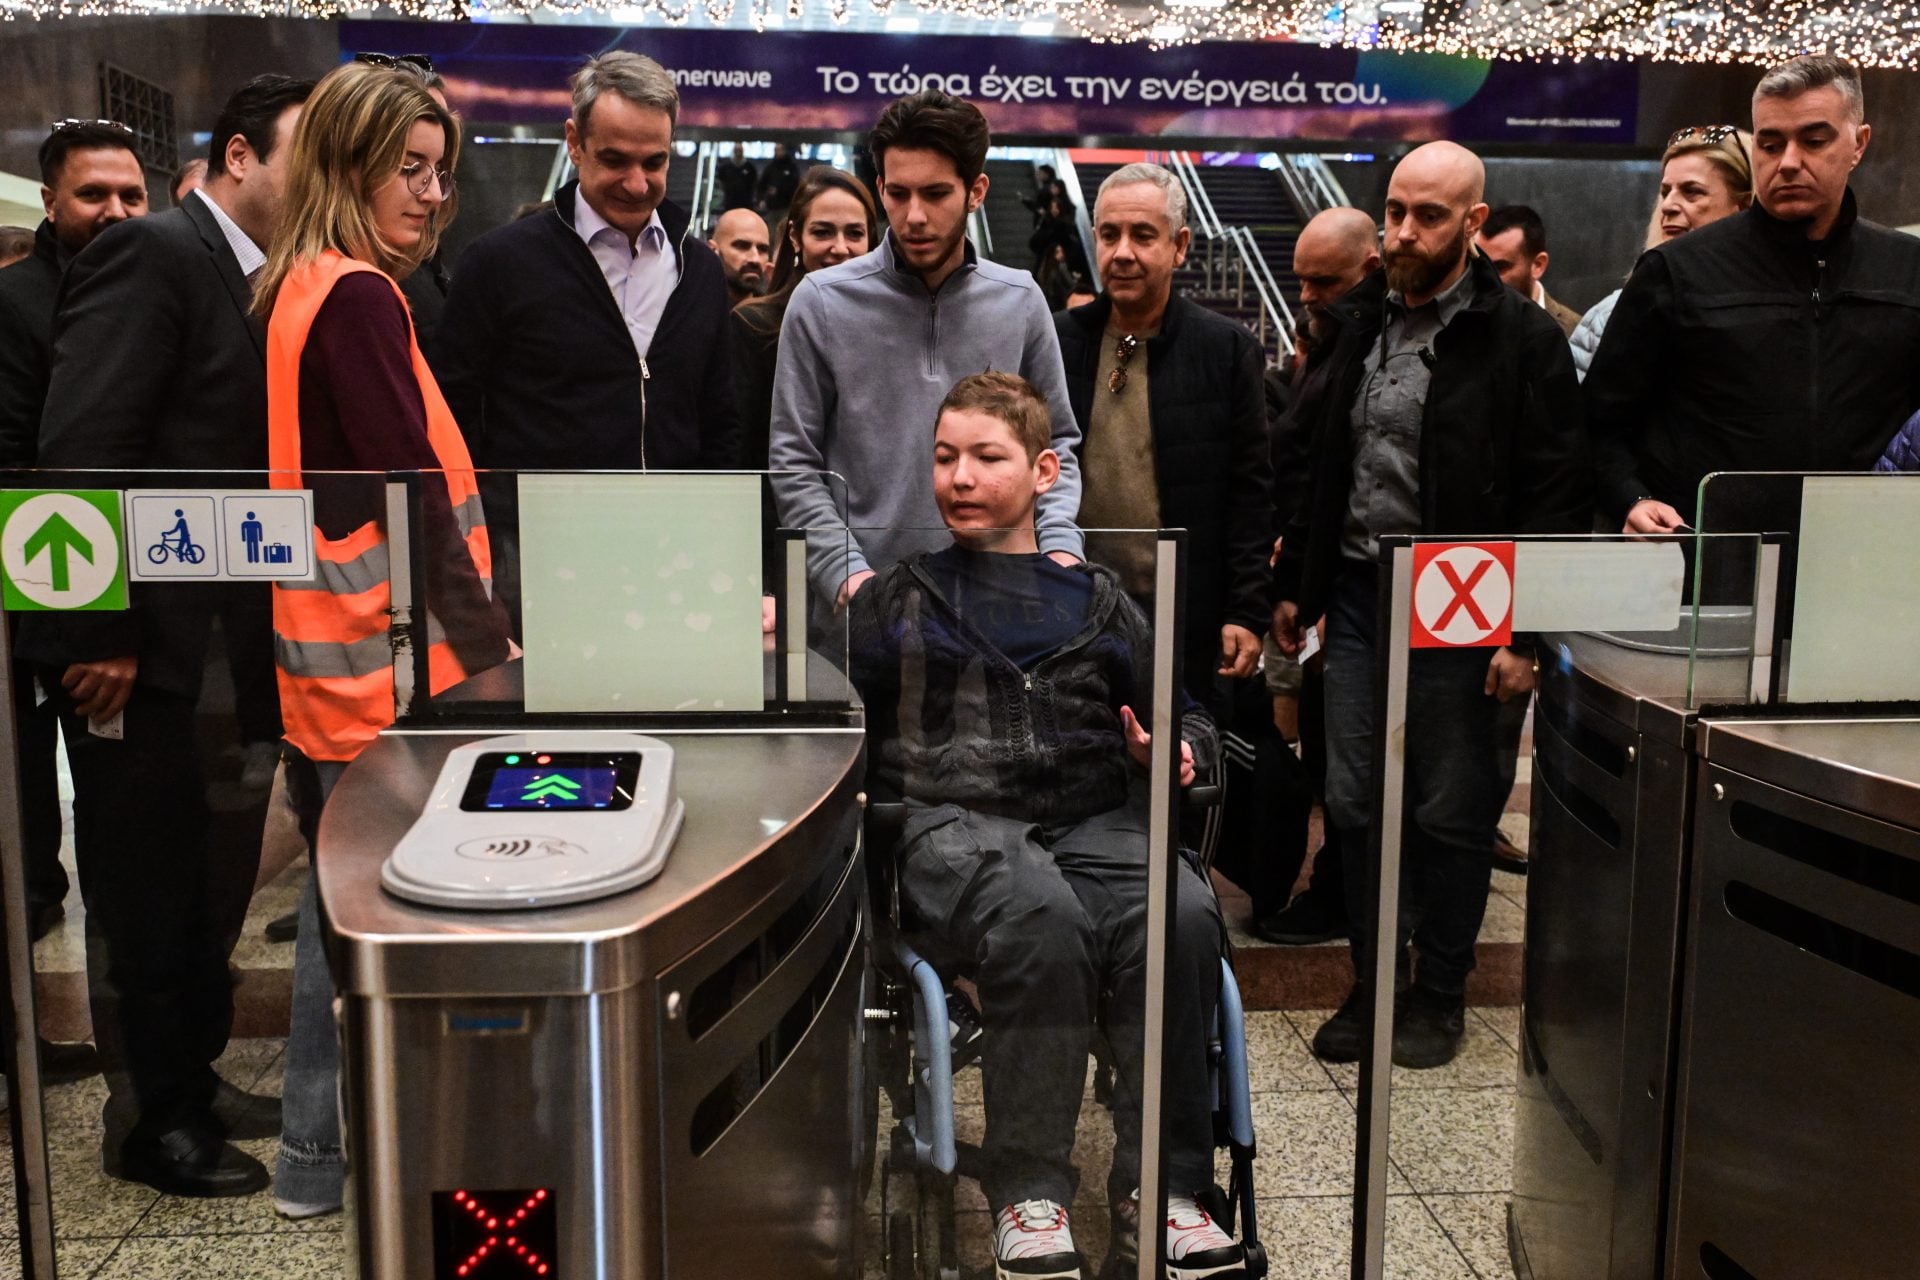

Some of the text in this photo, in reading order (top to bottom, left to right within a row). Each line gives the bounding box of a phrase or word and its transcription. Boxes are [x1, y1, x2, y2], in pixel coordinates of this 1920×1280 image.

[816, 64, 1387, 107] Το τώρα έχει την ενέργειά του.
